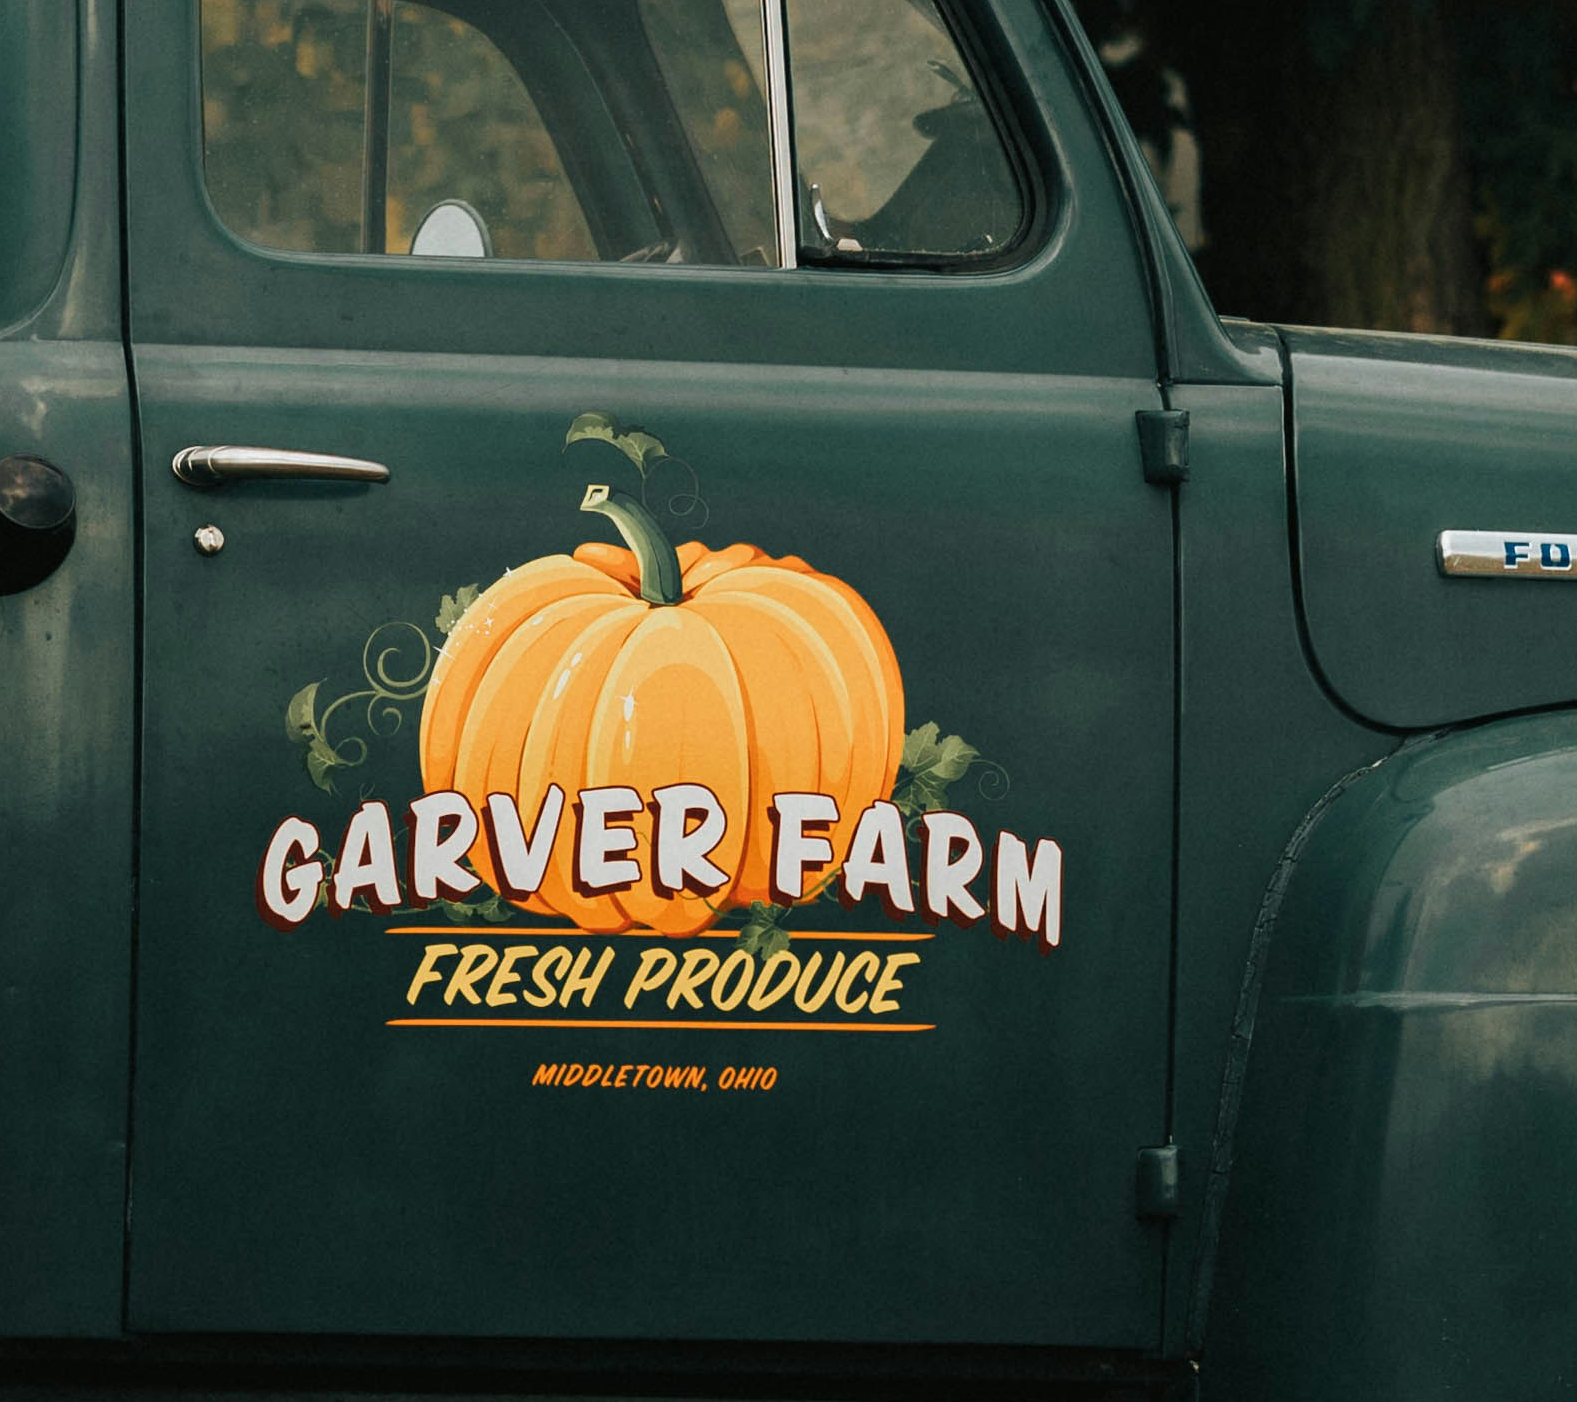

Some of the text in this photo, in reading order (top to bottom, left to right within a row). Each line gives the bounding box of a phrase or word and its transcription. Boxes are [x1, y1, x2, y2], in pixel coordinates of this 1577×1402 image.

[256, 783, 1063, 954] GARVER FARM
[406, 943, 920, 1014] FRESH PRODUCE
[532, 1064, 778, 1092] MIDDLETOWN, OHIO
